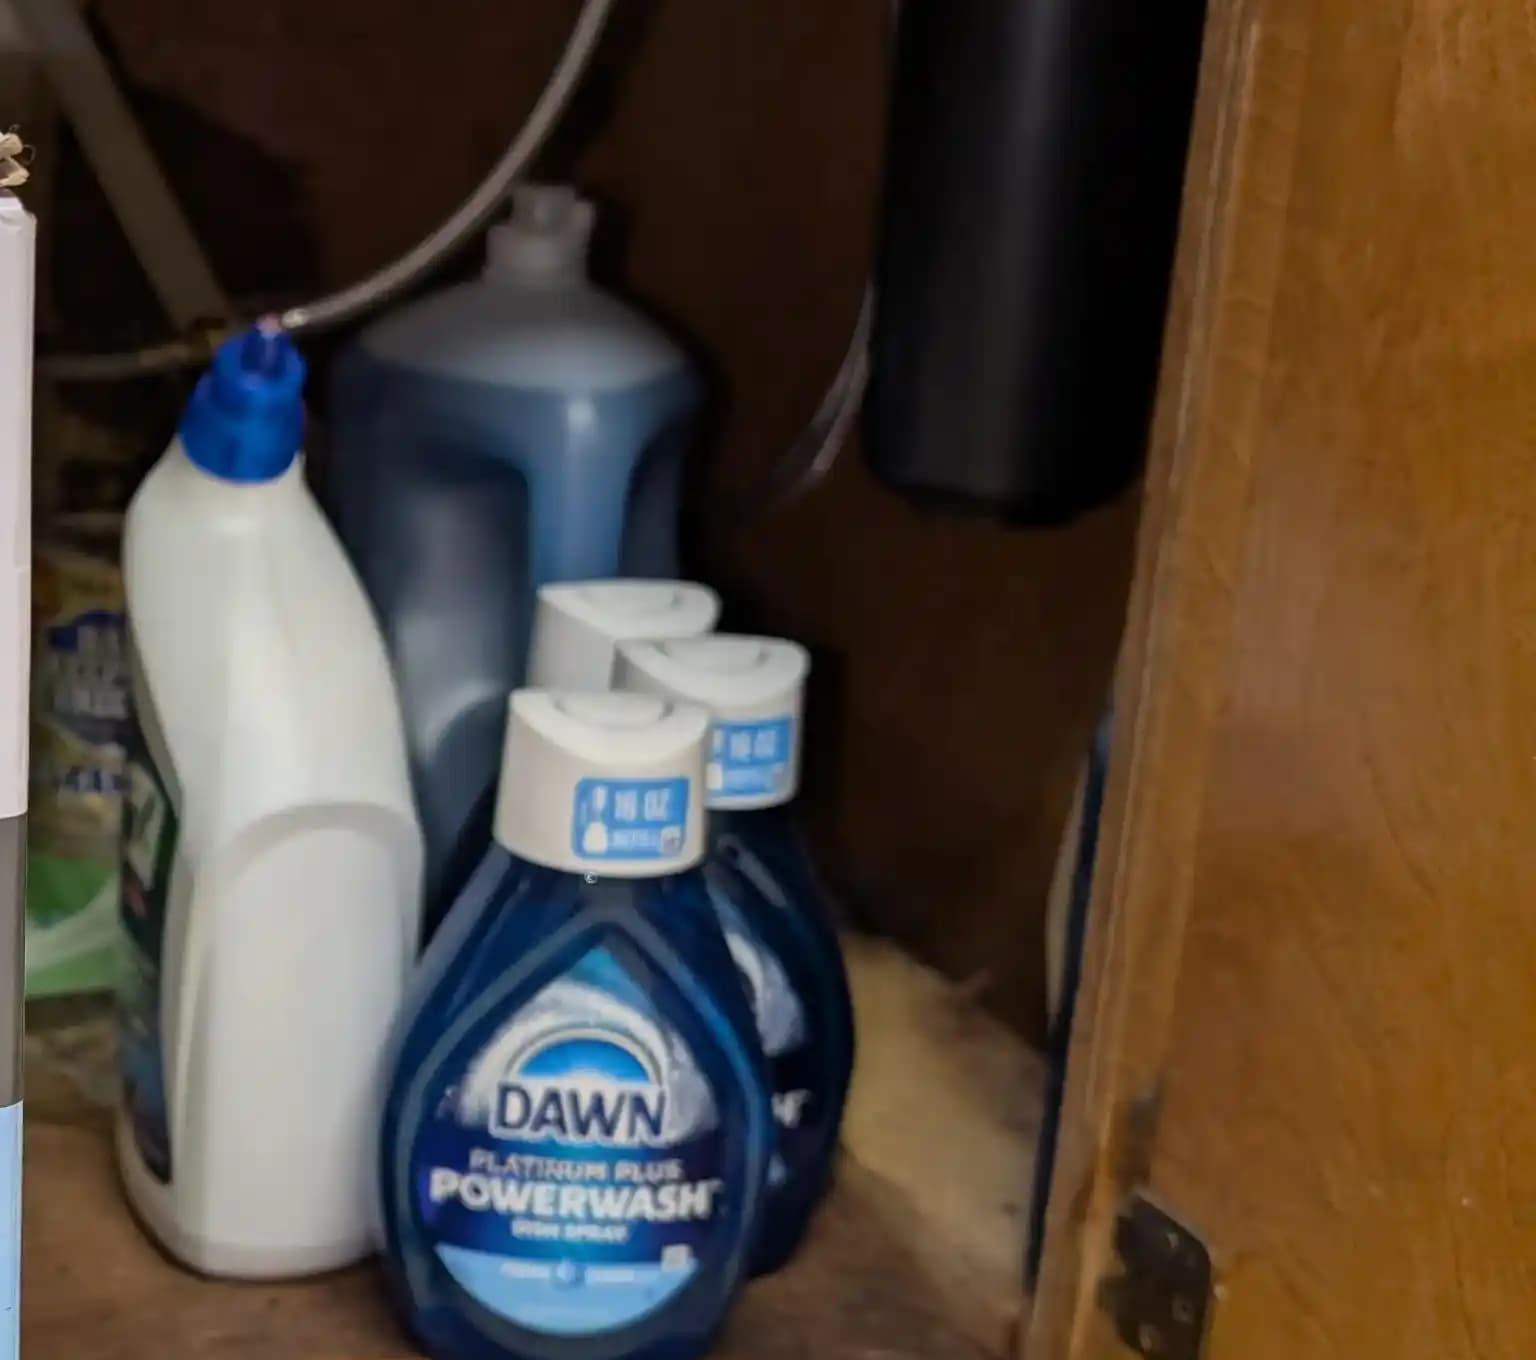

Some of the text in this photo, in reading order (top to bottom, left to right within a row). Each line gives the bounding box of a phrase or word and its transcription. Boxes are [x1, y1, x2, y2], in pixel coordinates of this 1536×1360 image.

[494, 1082, 663, 1138] DAWN
[469, 1149, 684, 1183] PLATINUM PLUS
